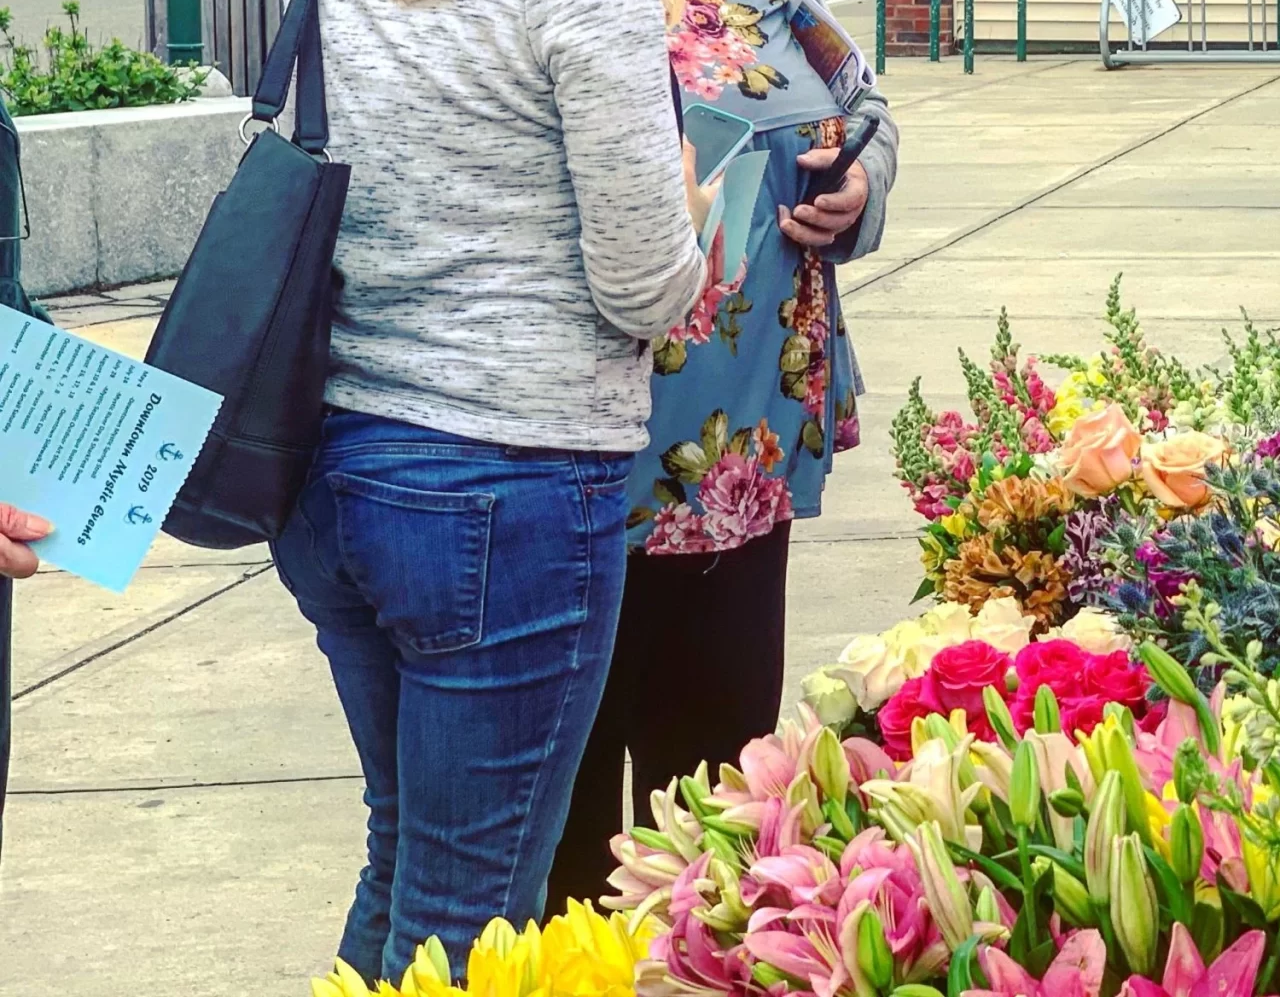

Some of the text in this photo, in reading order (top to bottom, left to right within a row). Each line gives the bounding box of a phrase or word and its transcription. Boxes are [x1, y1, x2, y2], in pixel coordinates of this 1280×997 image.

[14, 321, 31, 349] December
[40, 333, 57, 360] November
[57, 338, 70, 360] October
[66, 344, 83, 373] September
[84, 349, 96, 368] August
[97, 354, 109, 373] August
[138, 371, 148, 383] May
[95, 426, 105, 436] Day
[107, 428, 119, 446] Mystic
[97, 447, 110, 463] Spring
[78, 393, 161, 545] Downtown Mystic Events
[91, 464, 101, 479] Stroll
[138, 464, 157, 492] 2019
